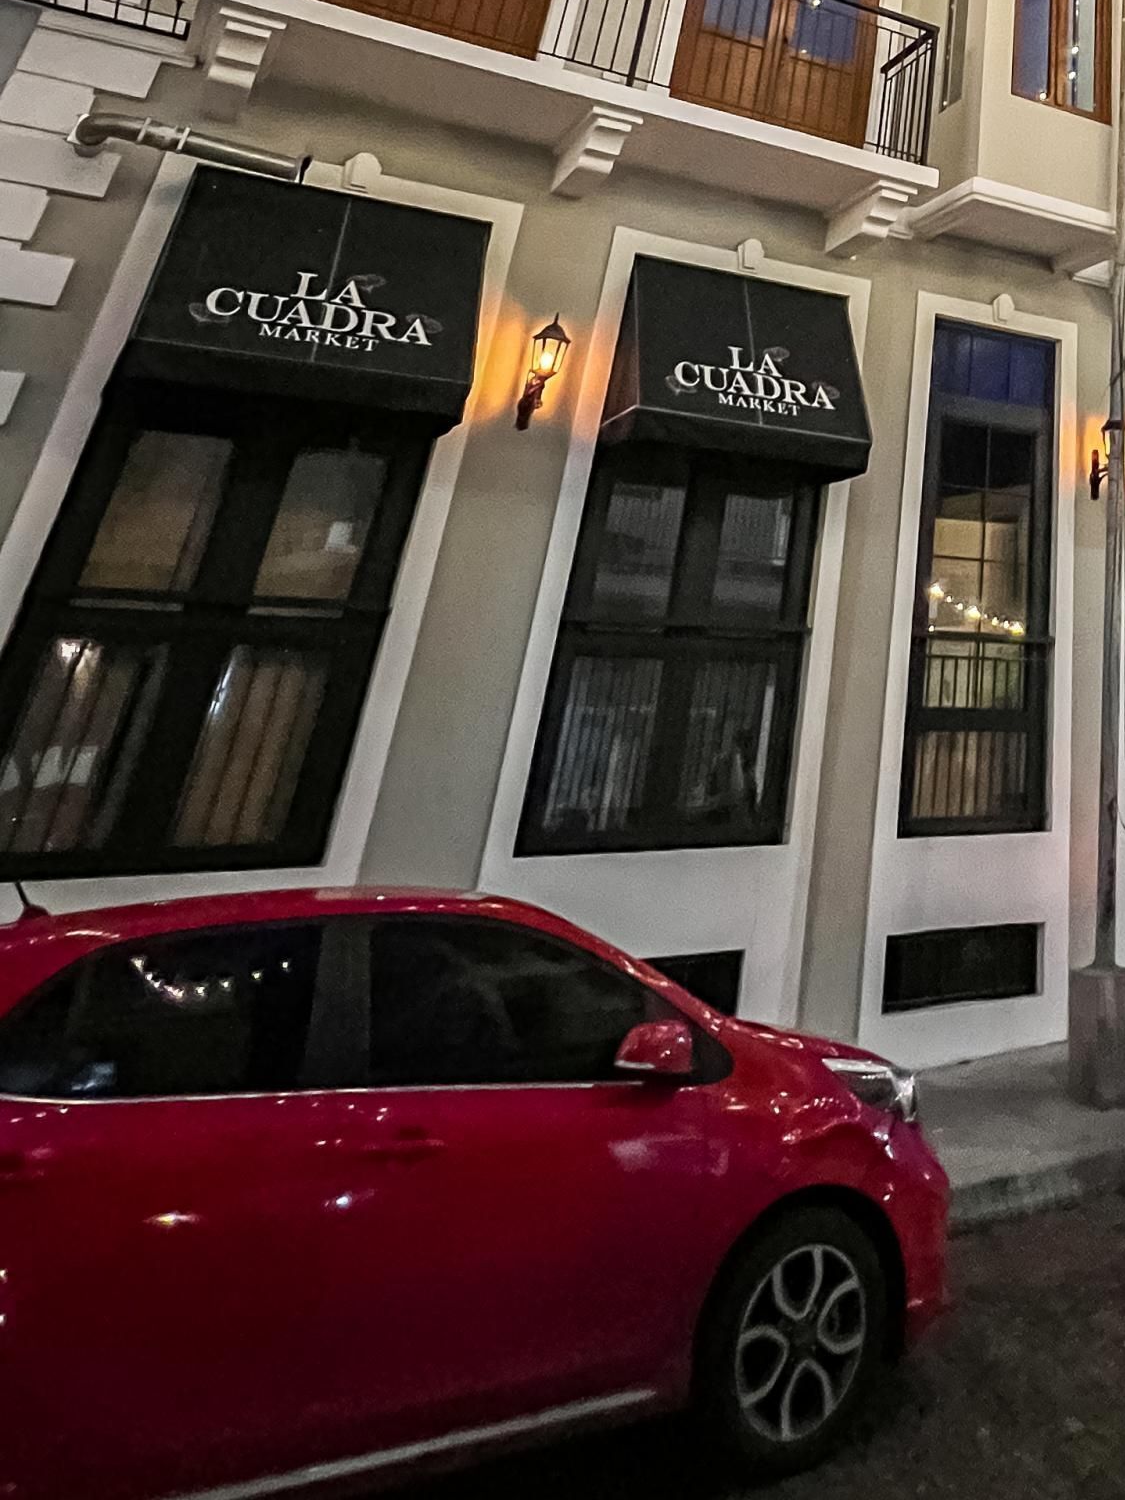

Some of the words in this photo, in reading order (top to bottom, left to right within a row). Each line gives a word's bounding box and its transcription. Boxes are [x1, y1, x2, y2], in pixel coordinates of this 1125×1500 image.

[290, 271, 366, 308] LA
[206, 287, 432, 346] CUADRA
[259, 323, 379, 351] MARKET
[728, 346, 782, 377] LA
[674, 361, 836, 410] CUADRA
[718, 393, 800, 416] MARKET
